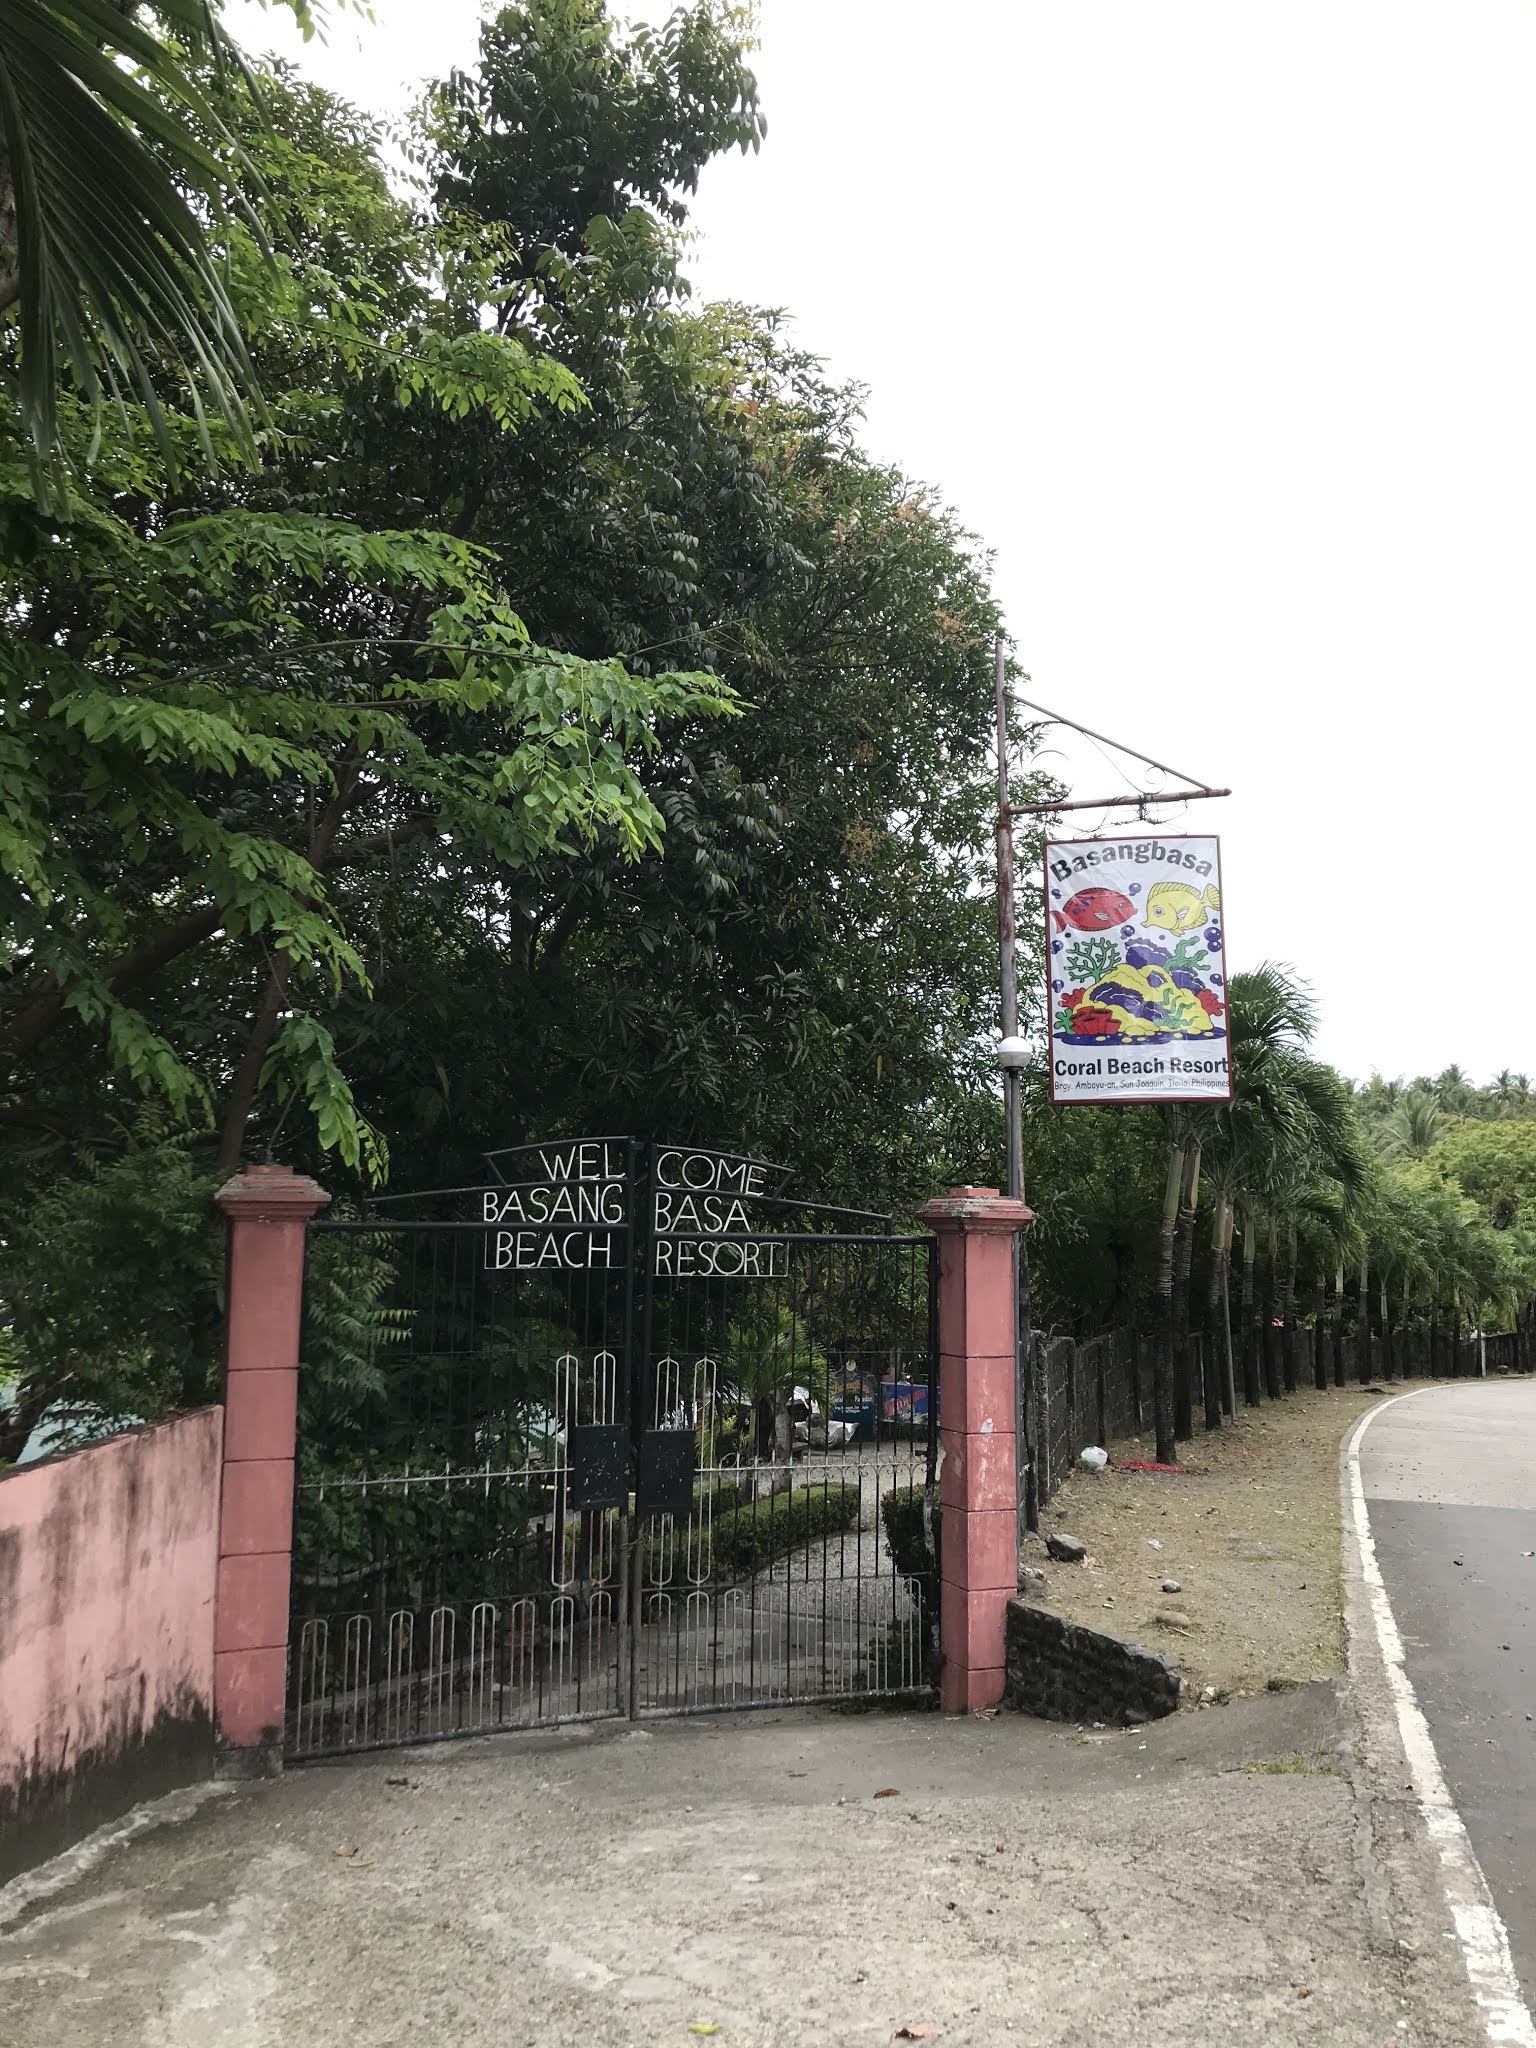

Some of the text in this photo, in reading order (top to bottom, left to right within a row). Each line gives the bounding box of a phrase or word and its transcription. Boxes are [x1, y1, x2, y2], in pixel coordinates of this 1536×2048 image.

[1050, 840, 1213, 882] Basangbasa
[1055, 1056, 1229, 1076] Coral Beach Resort
[1120, 1079, 1134, 1089] San
[1191, 1078, 1230, 1090] Philippines
[539, 1142, 768, 1197] WEL COME
[483, 1183, 751, 1233] BASANG BASA
[495, 1231, 785, 1276] BEACH RESORT
